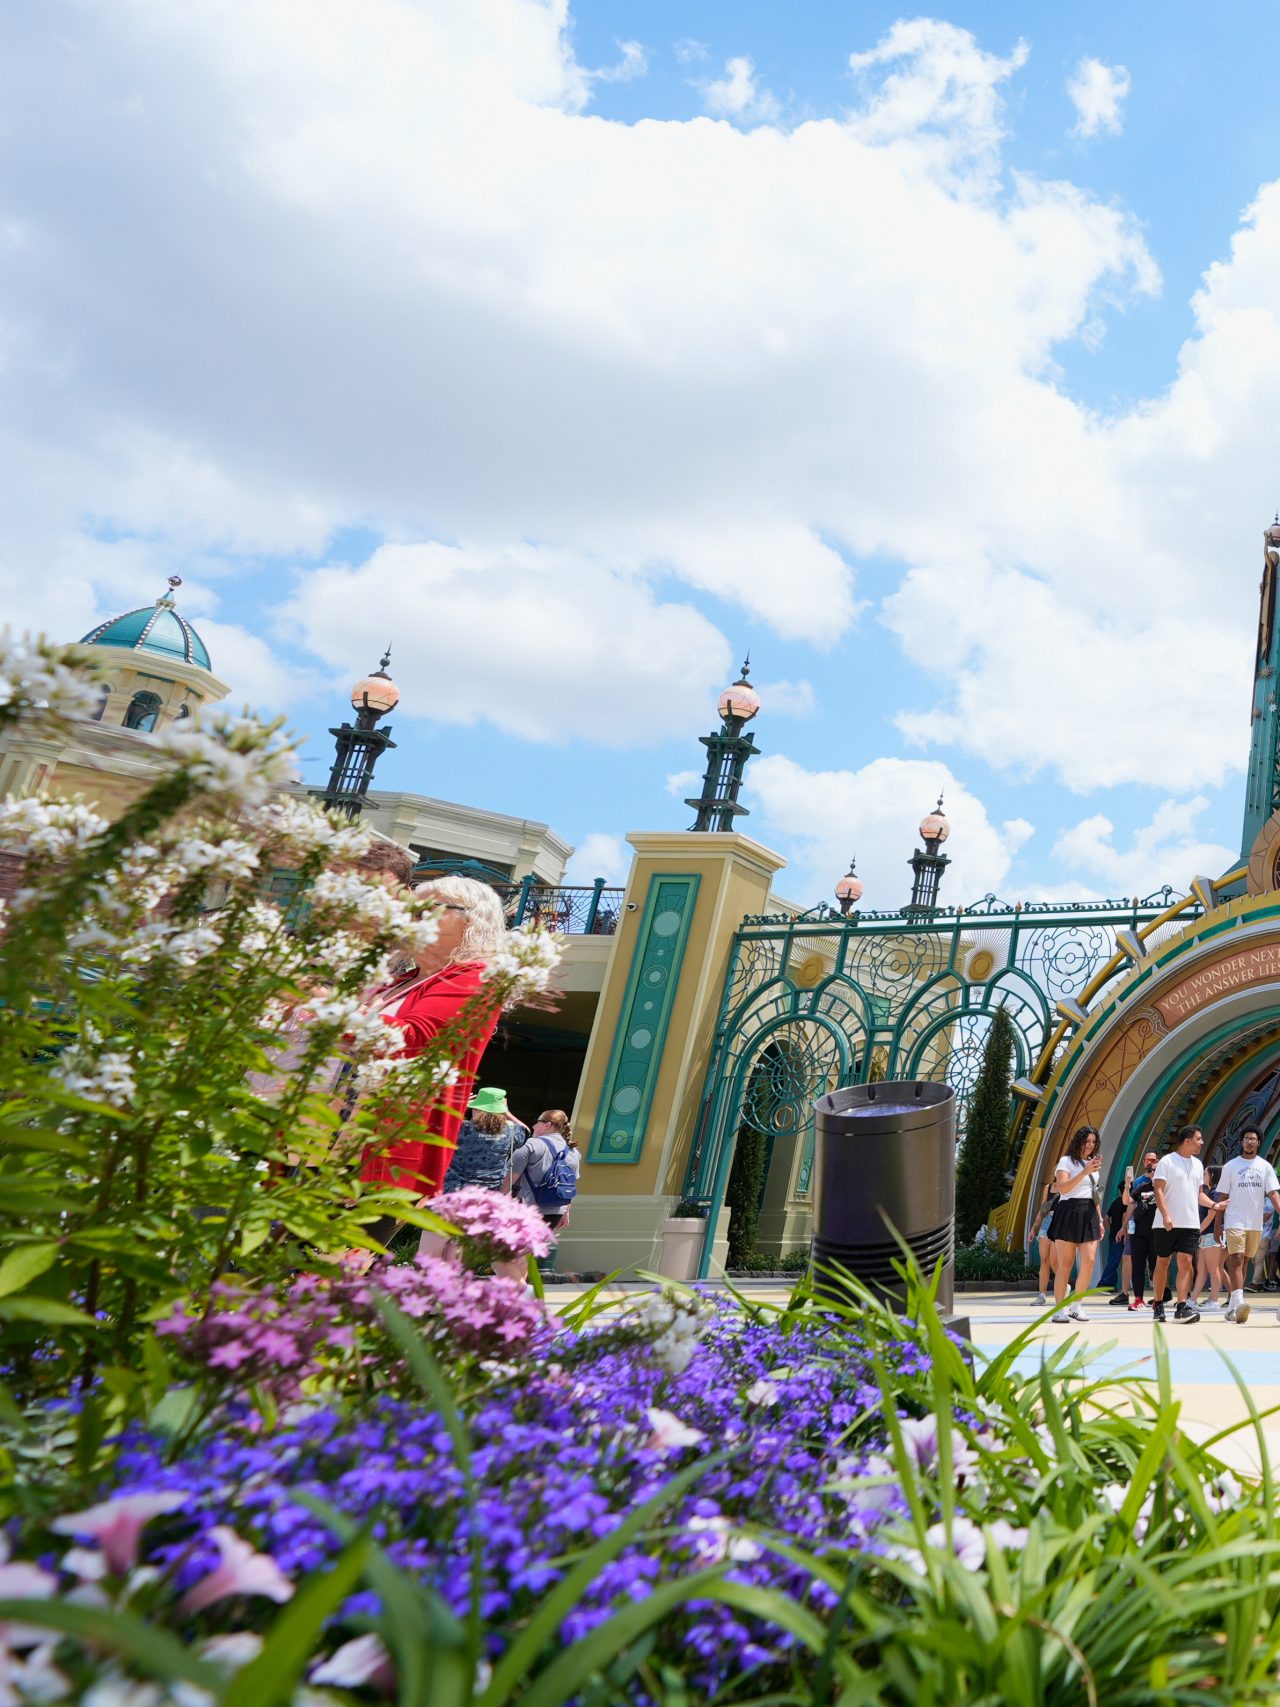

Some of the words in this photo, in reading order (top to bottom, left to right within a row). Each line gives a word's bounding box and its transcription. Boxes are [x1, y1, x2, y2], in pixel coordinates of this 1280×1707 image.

[1161, 987, 1188, 1010] YOU
[1190, 957, 1246, 989] WONDER
[1176, 991, 1202, 1014] THE
[1205, 968, 1255, 998] ANSWER
